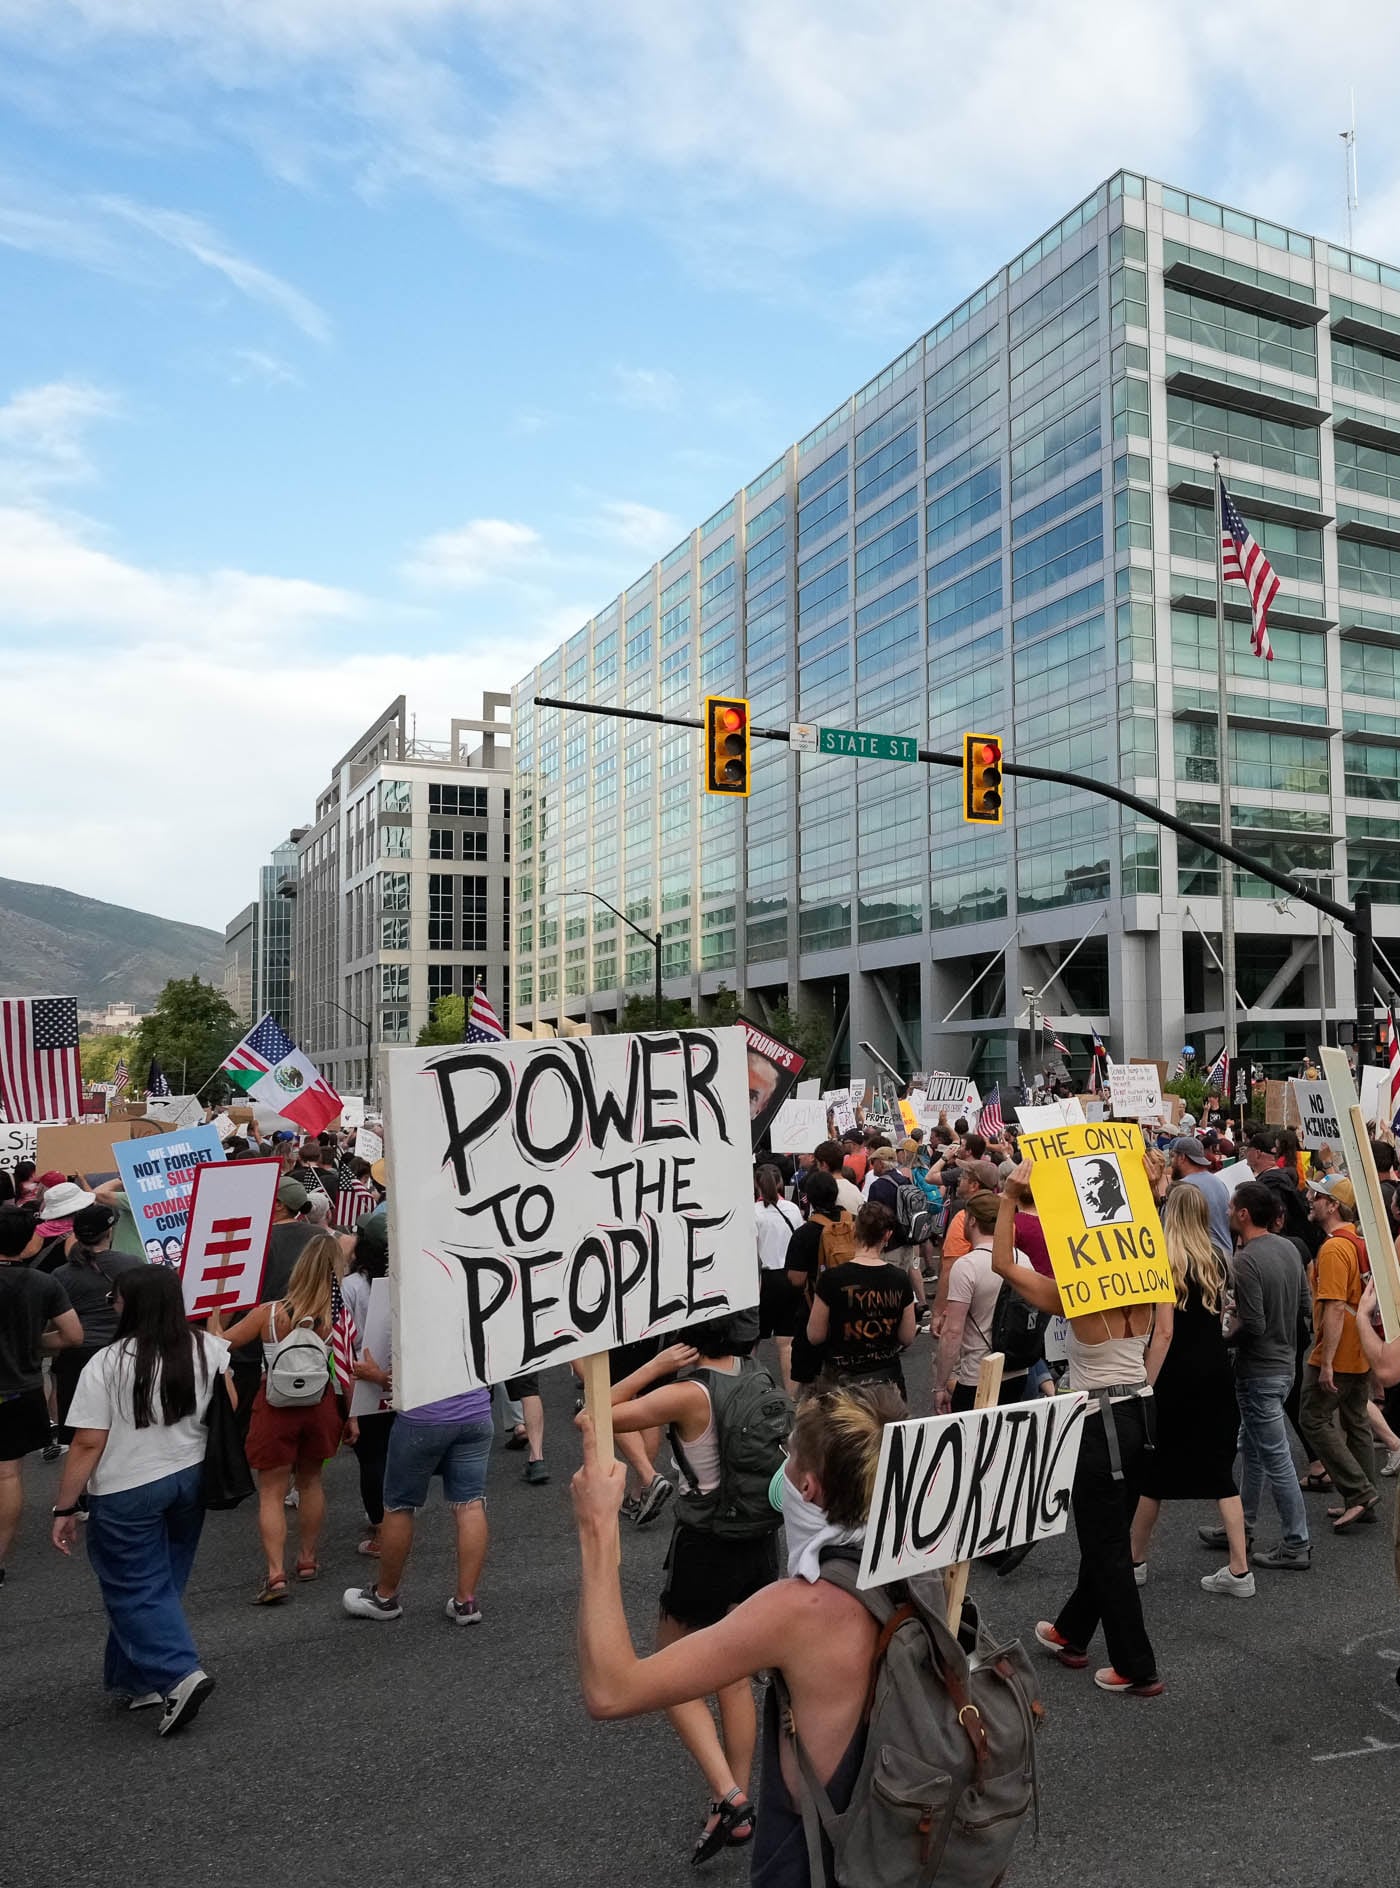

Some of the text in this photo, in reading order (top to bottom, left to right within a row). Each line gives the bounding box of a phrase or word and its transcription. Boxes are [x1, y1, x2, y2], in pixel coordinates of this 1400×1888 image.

[826, 733, 879, 754] STATE
[889, 740, 911, 758] ST.
[747, 1028, 795, 1068] TRUMP'S
[422, 1030, 734, 1196] POWER
[1308, 1094, 1325, 1114] NO
[1303, 1116, 1341, 1139] KINGS
[147, 1142, 193, 1160] WE WILL
[1023, 1127, 1135, 1163] THE ONLY
[133, 1148, 213, 1179] NOT FORGET
[136, 1177, 165, 1193] THE
[165, 1188, 178, 1200] OF
[591, 1156, 704, 1222] THE
[456, 1183, 555, 1247] TO
[1066, 1226, 1156, 1269] KING
[444, 1210, 735, 1385] PEOPLE
[840, 1284, 904, 1310] TYRANNY
[1061, 1269, 1171, 1308] TO FOLLOW
